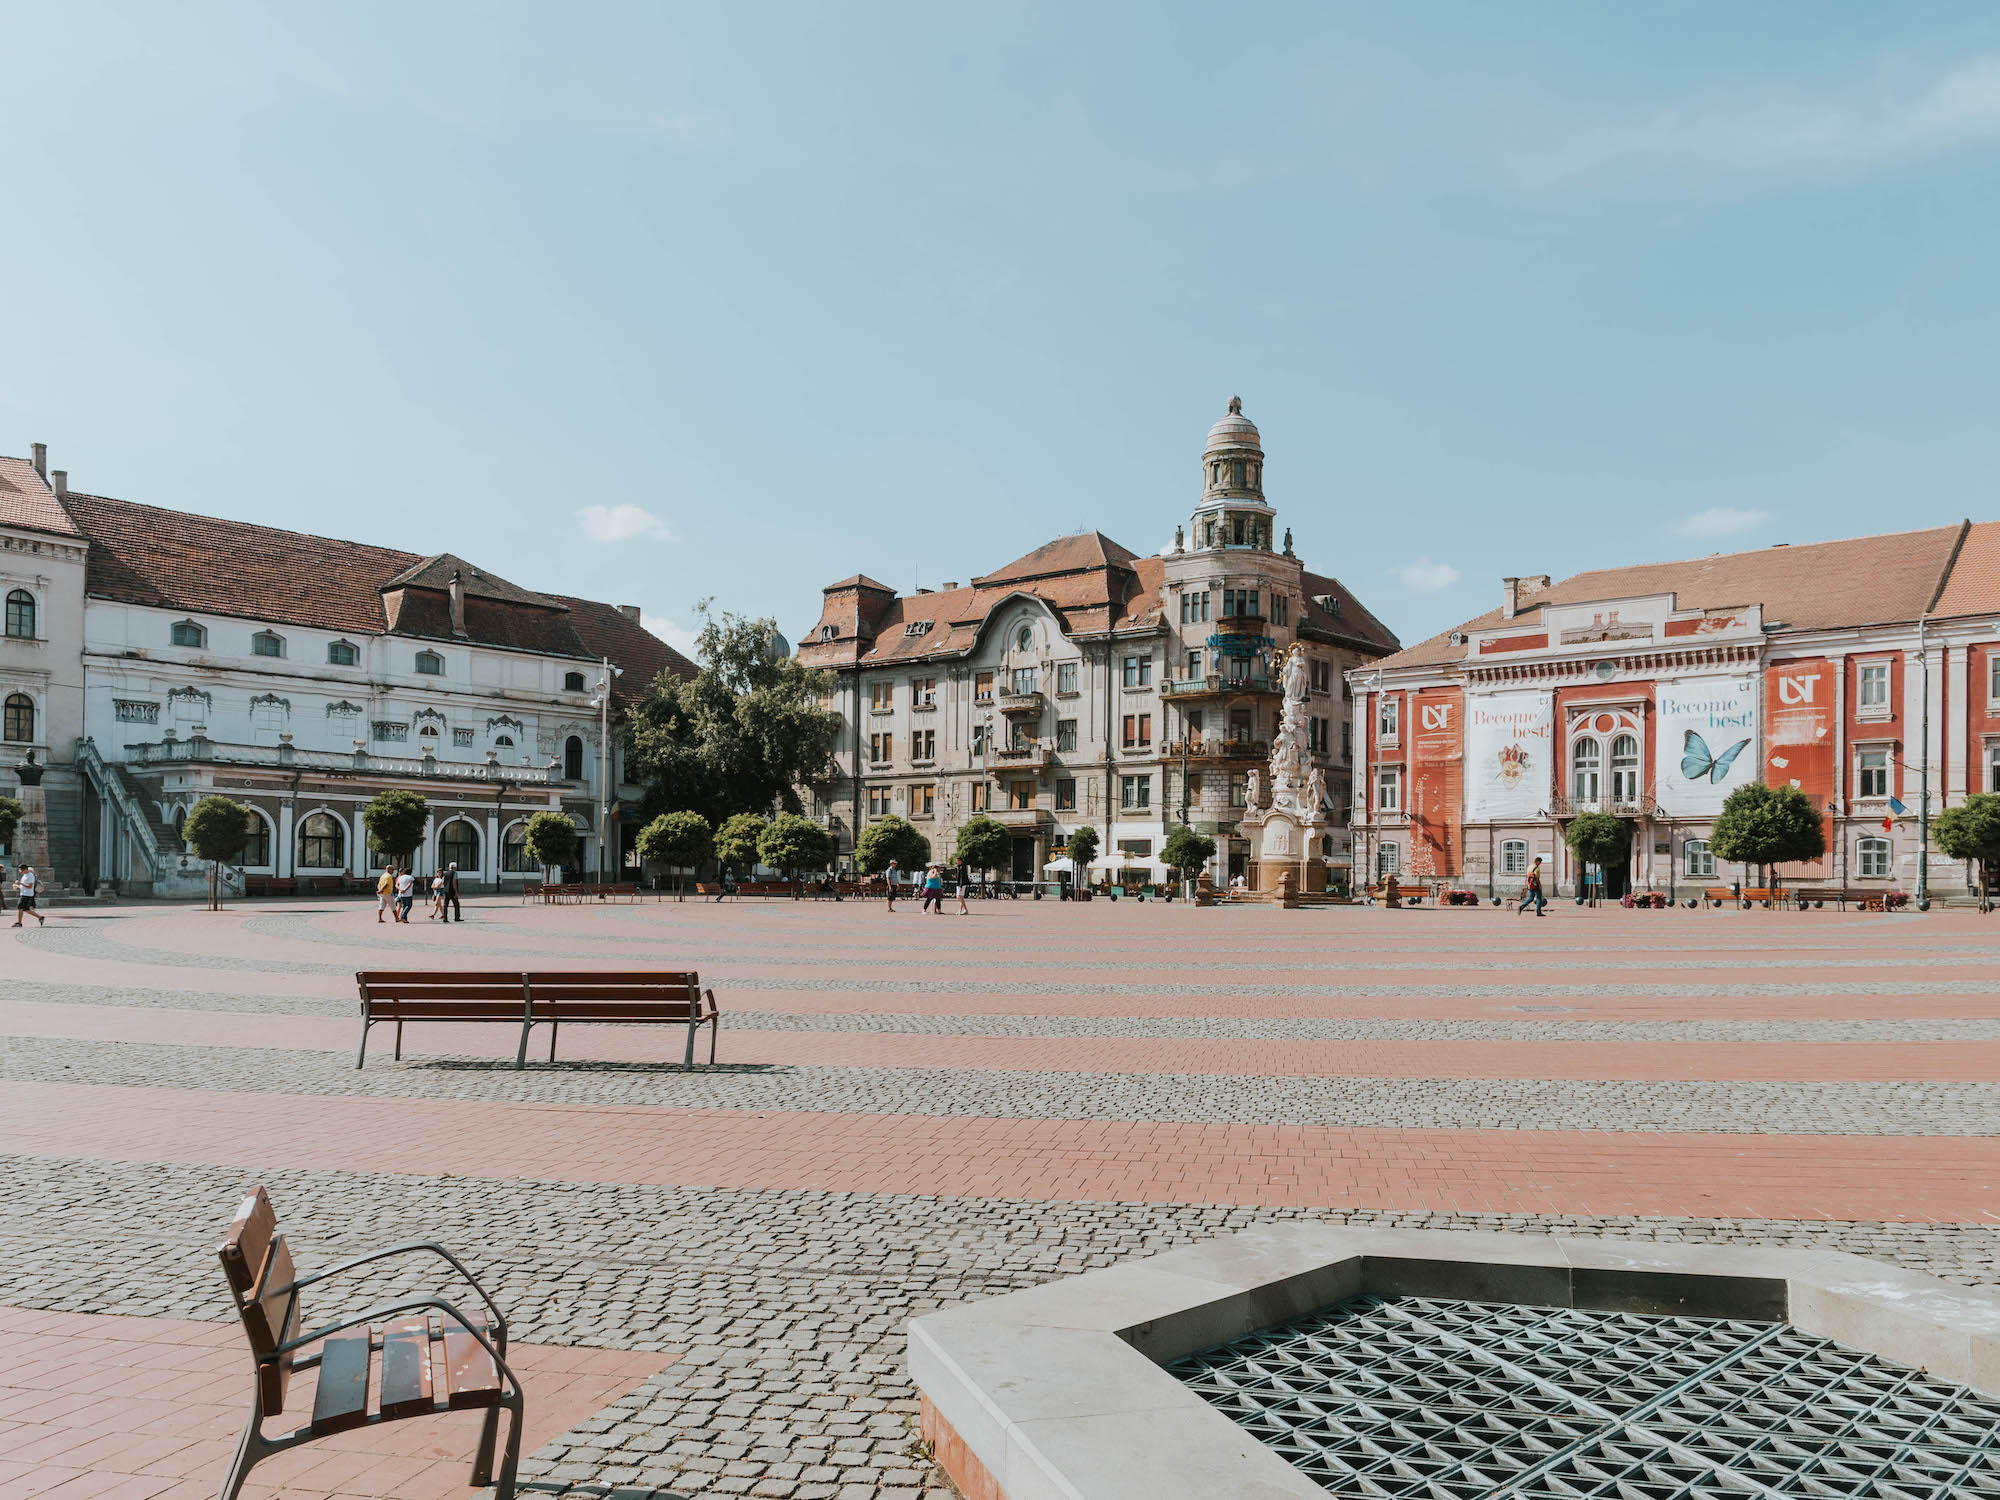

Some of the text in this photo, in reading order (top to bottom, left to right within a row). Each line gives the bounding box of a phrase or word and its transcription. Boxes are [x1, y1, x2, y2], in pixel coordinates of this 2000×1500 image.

[1205, 633, 1275, 648] WEST CITY
[1662, 699, 1738, 715] Become
[1473, 711, 1538, 725] Become
[1709, 711, 1752, 728] best!
[1513, 723, 1550, 738] best!
